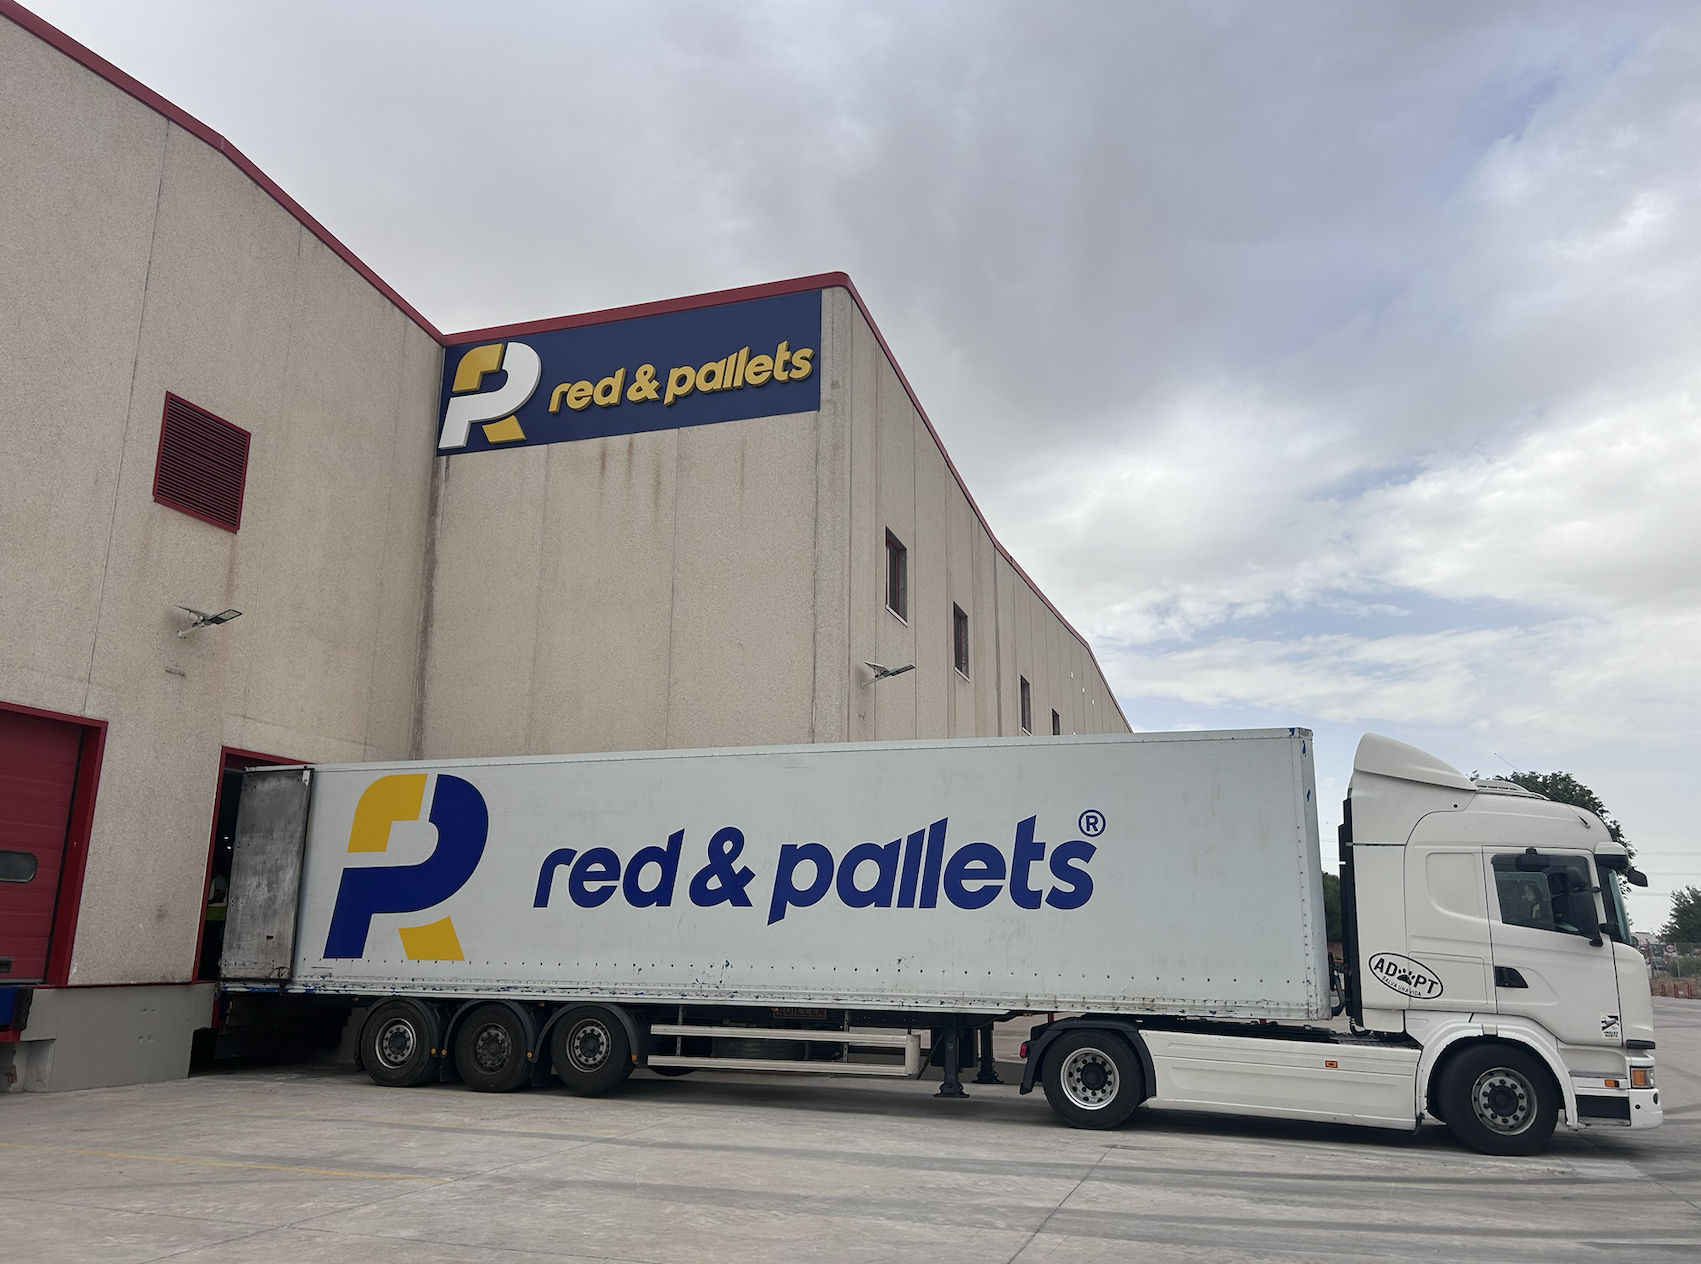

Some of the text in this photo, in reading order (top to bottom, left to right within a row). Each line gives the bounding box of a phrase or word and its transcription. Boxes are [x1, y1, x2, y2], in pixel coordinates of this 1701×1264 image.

[548, 340, 814, 413] red & pallets
[533, 828, 685, 908] red
[689, 826, 756, 907] &
[1382, 975, 1398, 988] SALVA
